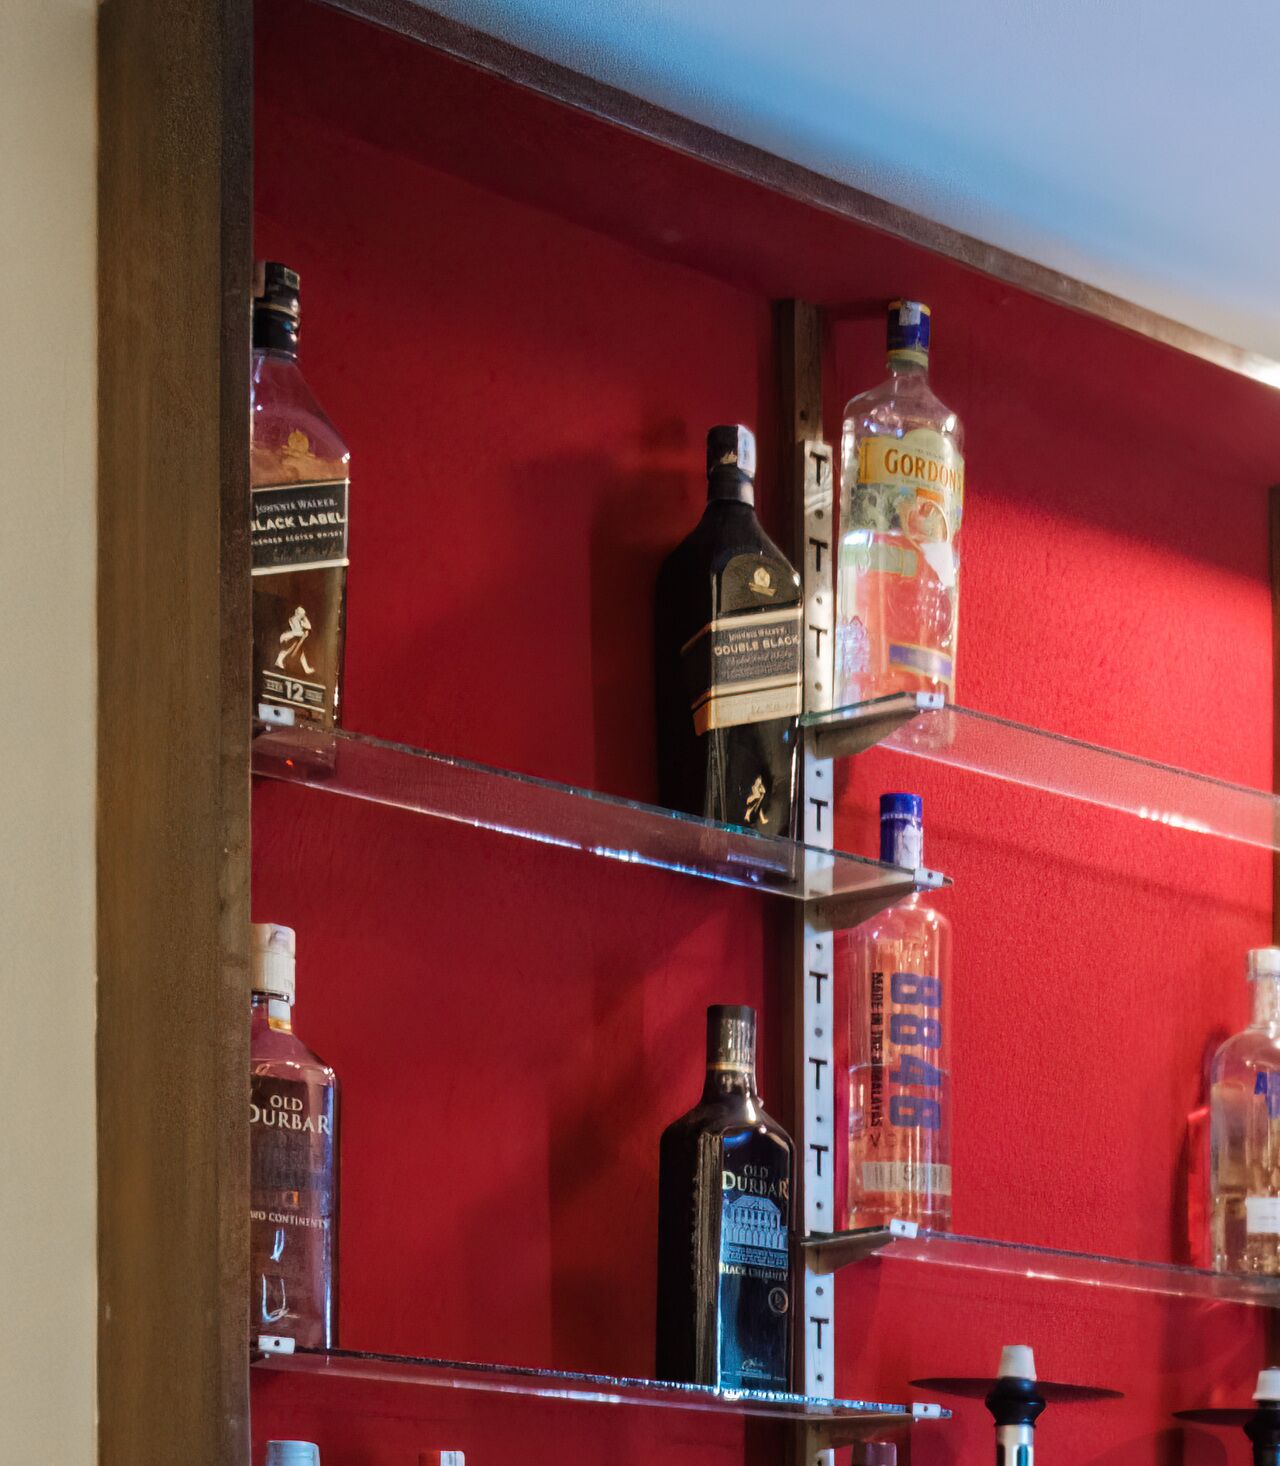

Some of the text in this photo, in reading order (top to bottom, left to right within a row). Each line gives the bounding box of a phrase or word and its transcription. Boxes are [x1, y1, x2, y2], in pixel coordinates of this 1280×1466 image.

[884, 448, 963, 495] GORDON
[298, 512, 347, 527] LABEL
[761, 632, 801, 649] BLACK
[285, 680, 305, 703] 12
[889, 972, 942, 1130] 8848
[269, 1094, 304, 1112] OLD
[743, 1163, 769, 1179] OLD
[249, 1209, 267, 1221] WO
